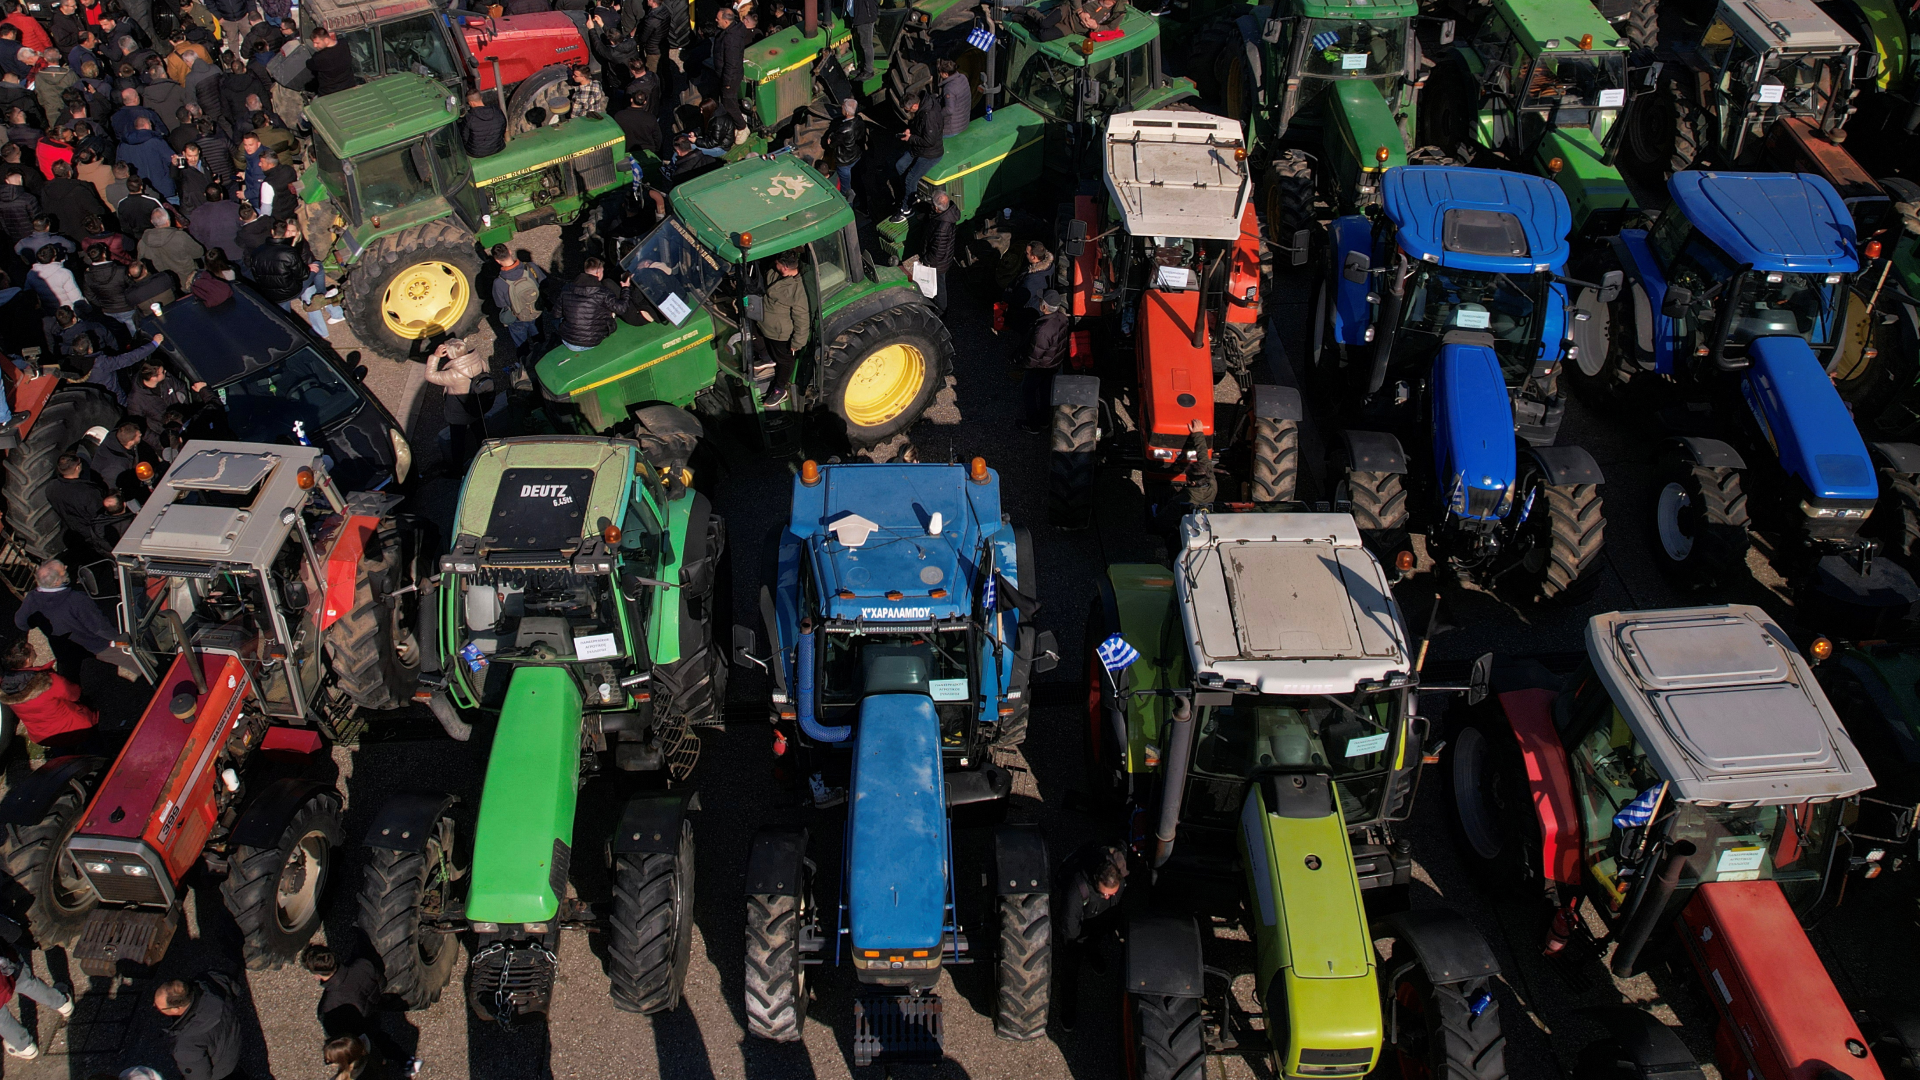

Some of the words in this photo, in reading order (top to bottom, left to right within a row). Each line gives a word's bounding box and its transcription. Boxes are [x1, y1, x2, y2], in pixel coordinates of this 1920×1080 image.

[491, 174, 508, 183] JOHN
[520, 485, 568, 497] DEUTZ
[212, 714, 228, 742] MASSEY
[226, 679, 246, 714] FERGUSON
[162, 806, 180, 835] 399
